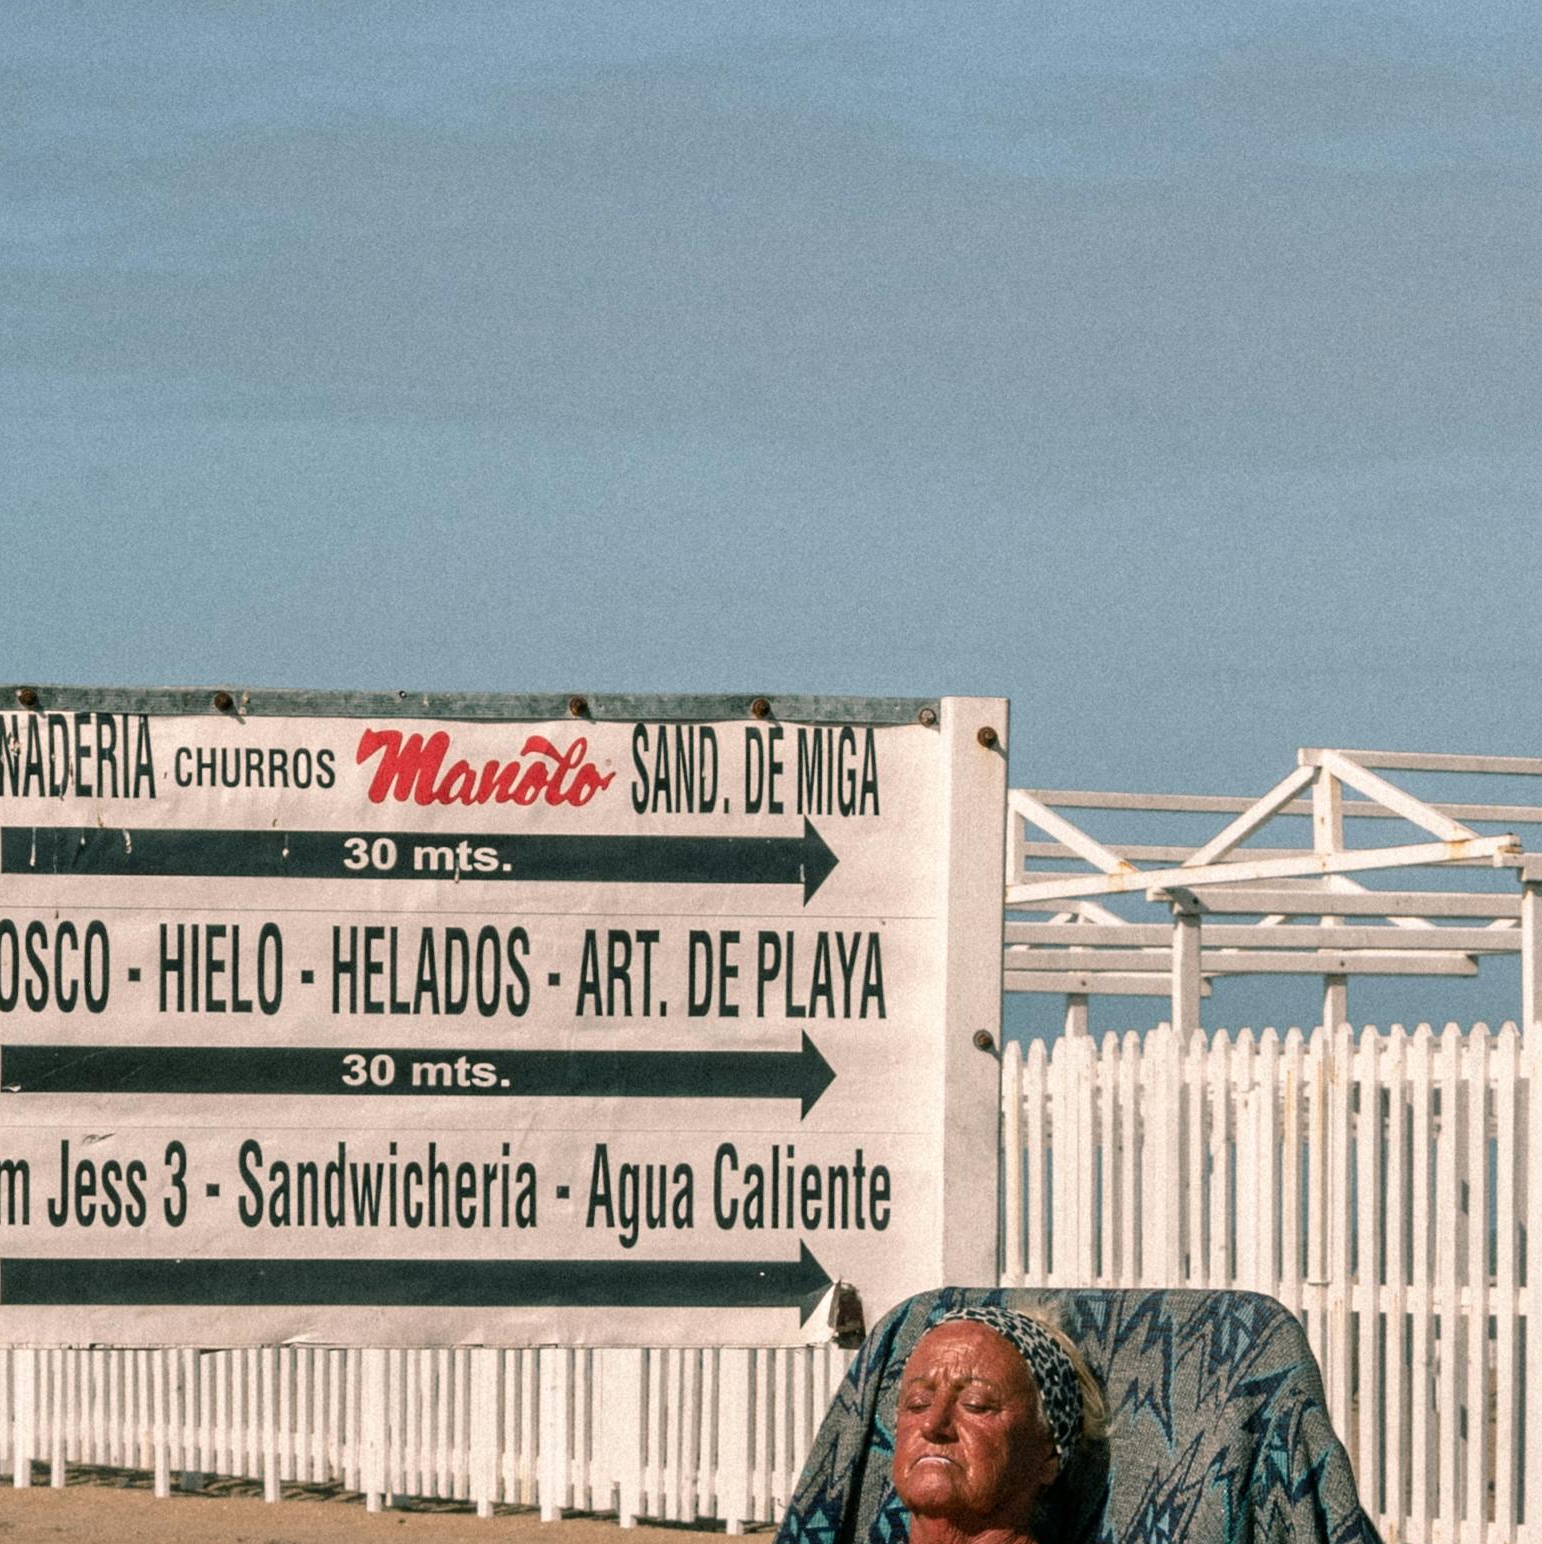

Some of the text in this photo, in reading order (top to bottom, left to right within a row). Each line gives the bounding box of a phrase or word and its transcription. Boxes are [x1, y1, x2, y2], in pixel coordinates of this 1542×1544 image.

[175, 747, 336, 789] CHURROS
[355, 728, 615, 808] Manolo
[631, 721, 730, 815] SAND.
[745, 726, 784, 815] DE
[797, 726, 880, 818] MIGA
[343, 837, 512, 872] 30 mts.
[128, 968, 141, 982] -
[159, 922, 283, 1016] HIELO
[301, 970, 314, 984] -
[332, 925, 530, 1018] HELADOS
[548, 972, 561, 986] -
[575, 929, 667, 1017] ART.
[688, 930, 740, 1018] DE
[757, 930, 886, 1019] PLAYA
[341, 1054, 511, 1088] 30 mts.
[47, 1139, 147, 1228] Jess
[163, 1140, 187, 1228] 3
[206, 1183, 220, 1197] -
[238, 1139, 537, 1229] Sandwicheria
[556, 1185, 570, 1199] -
[585, 1143, 694, 1249] Agua
[713, 1142, 891, 1231] Caliente
